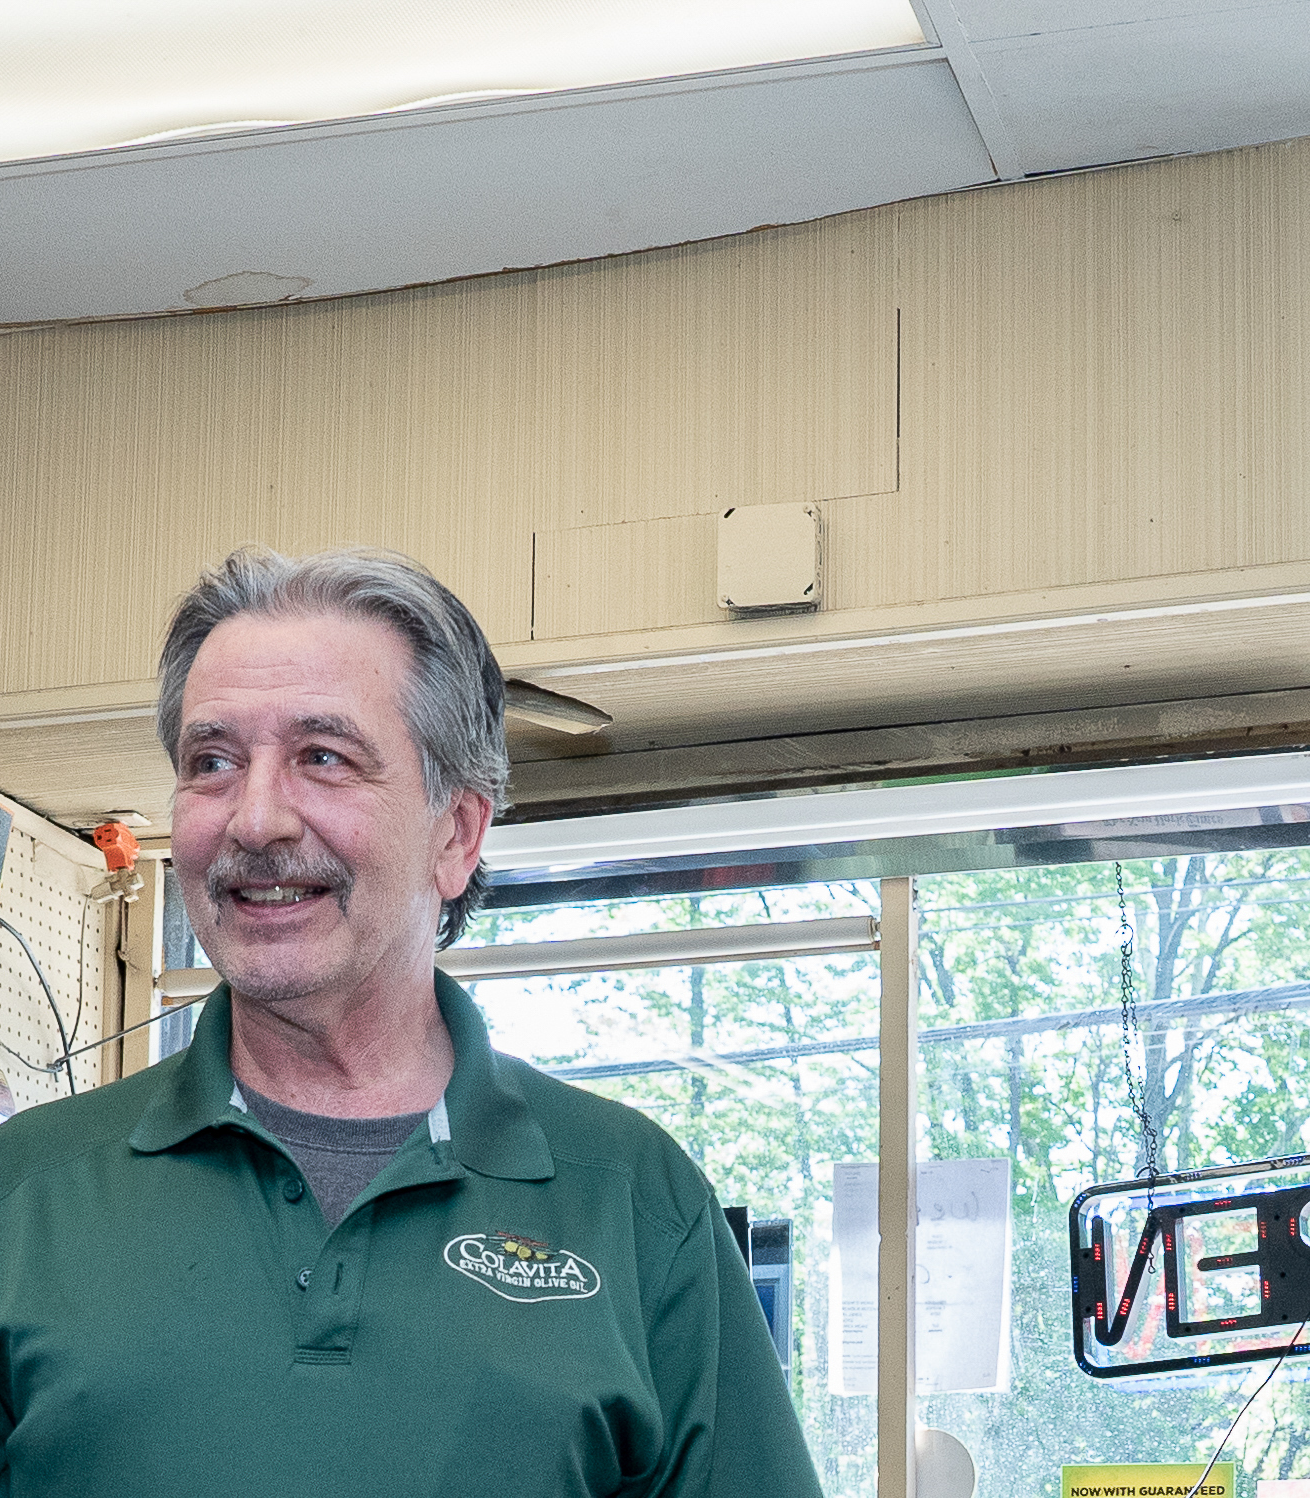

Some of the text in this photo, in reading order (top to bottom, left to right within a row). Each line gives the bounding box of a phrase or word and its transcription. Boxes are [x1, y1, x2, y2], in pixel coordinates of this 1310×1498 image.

[459, 1259, 589, 1293] EXTRA VIRGIN OLIVE OIL
[460, 1240, 588, 1282] COLAVITA
[1071, 1487, 1100, 1497] NOW
[1102, 1486, 1136, 1496] WITH
